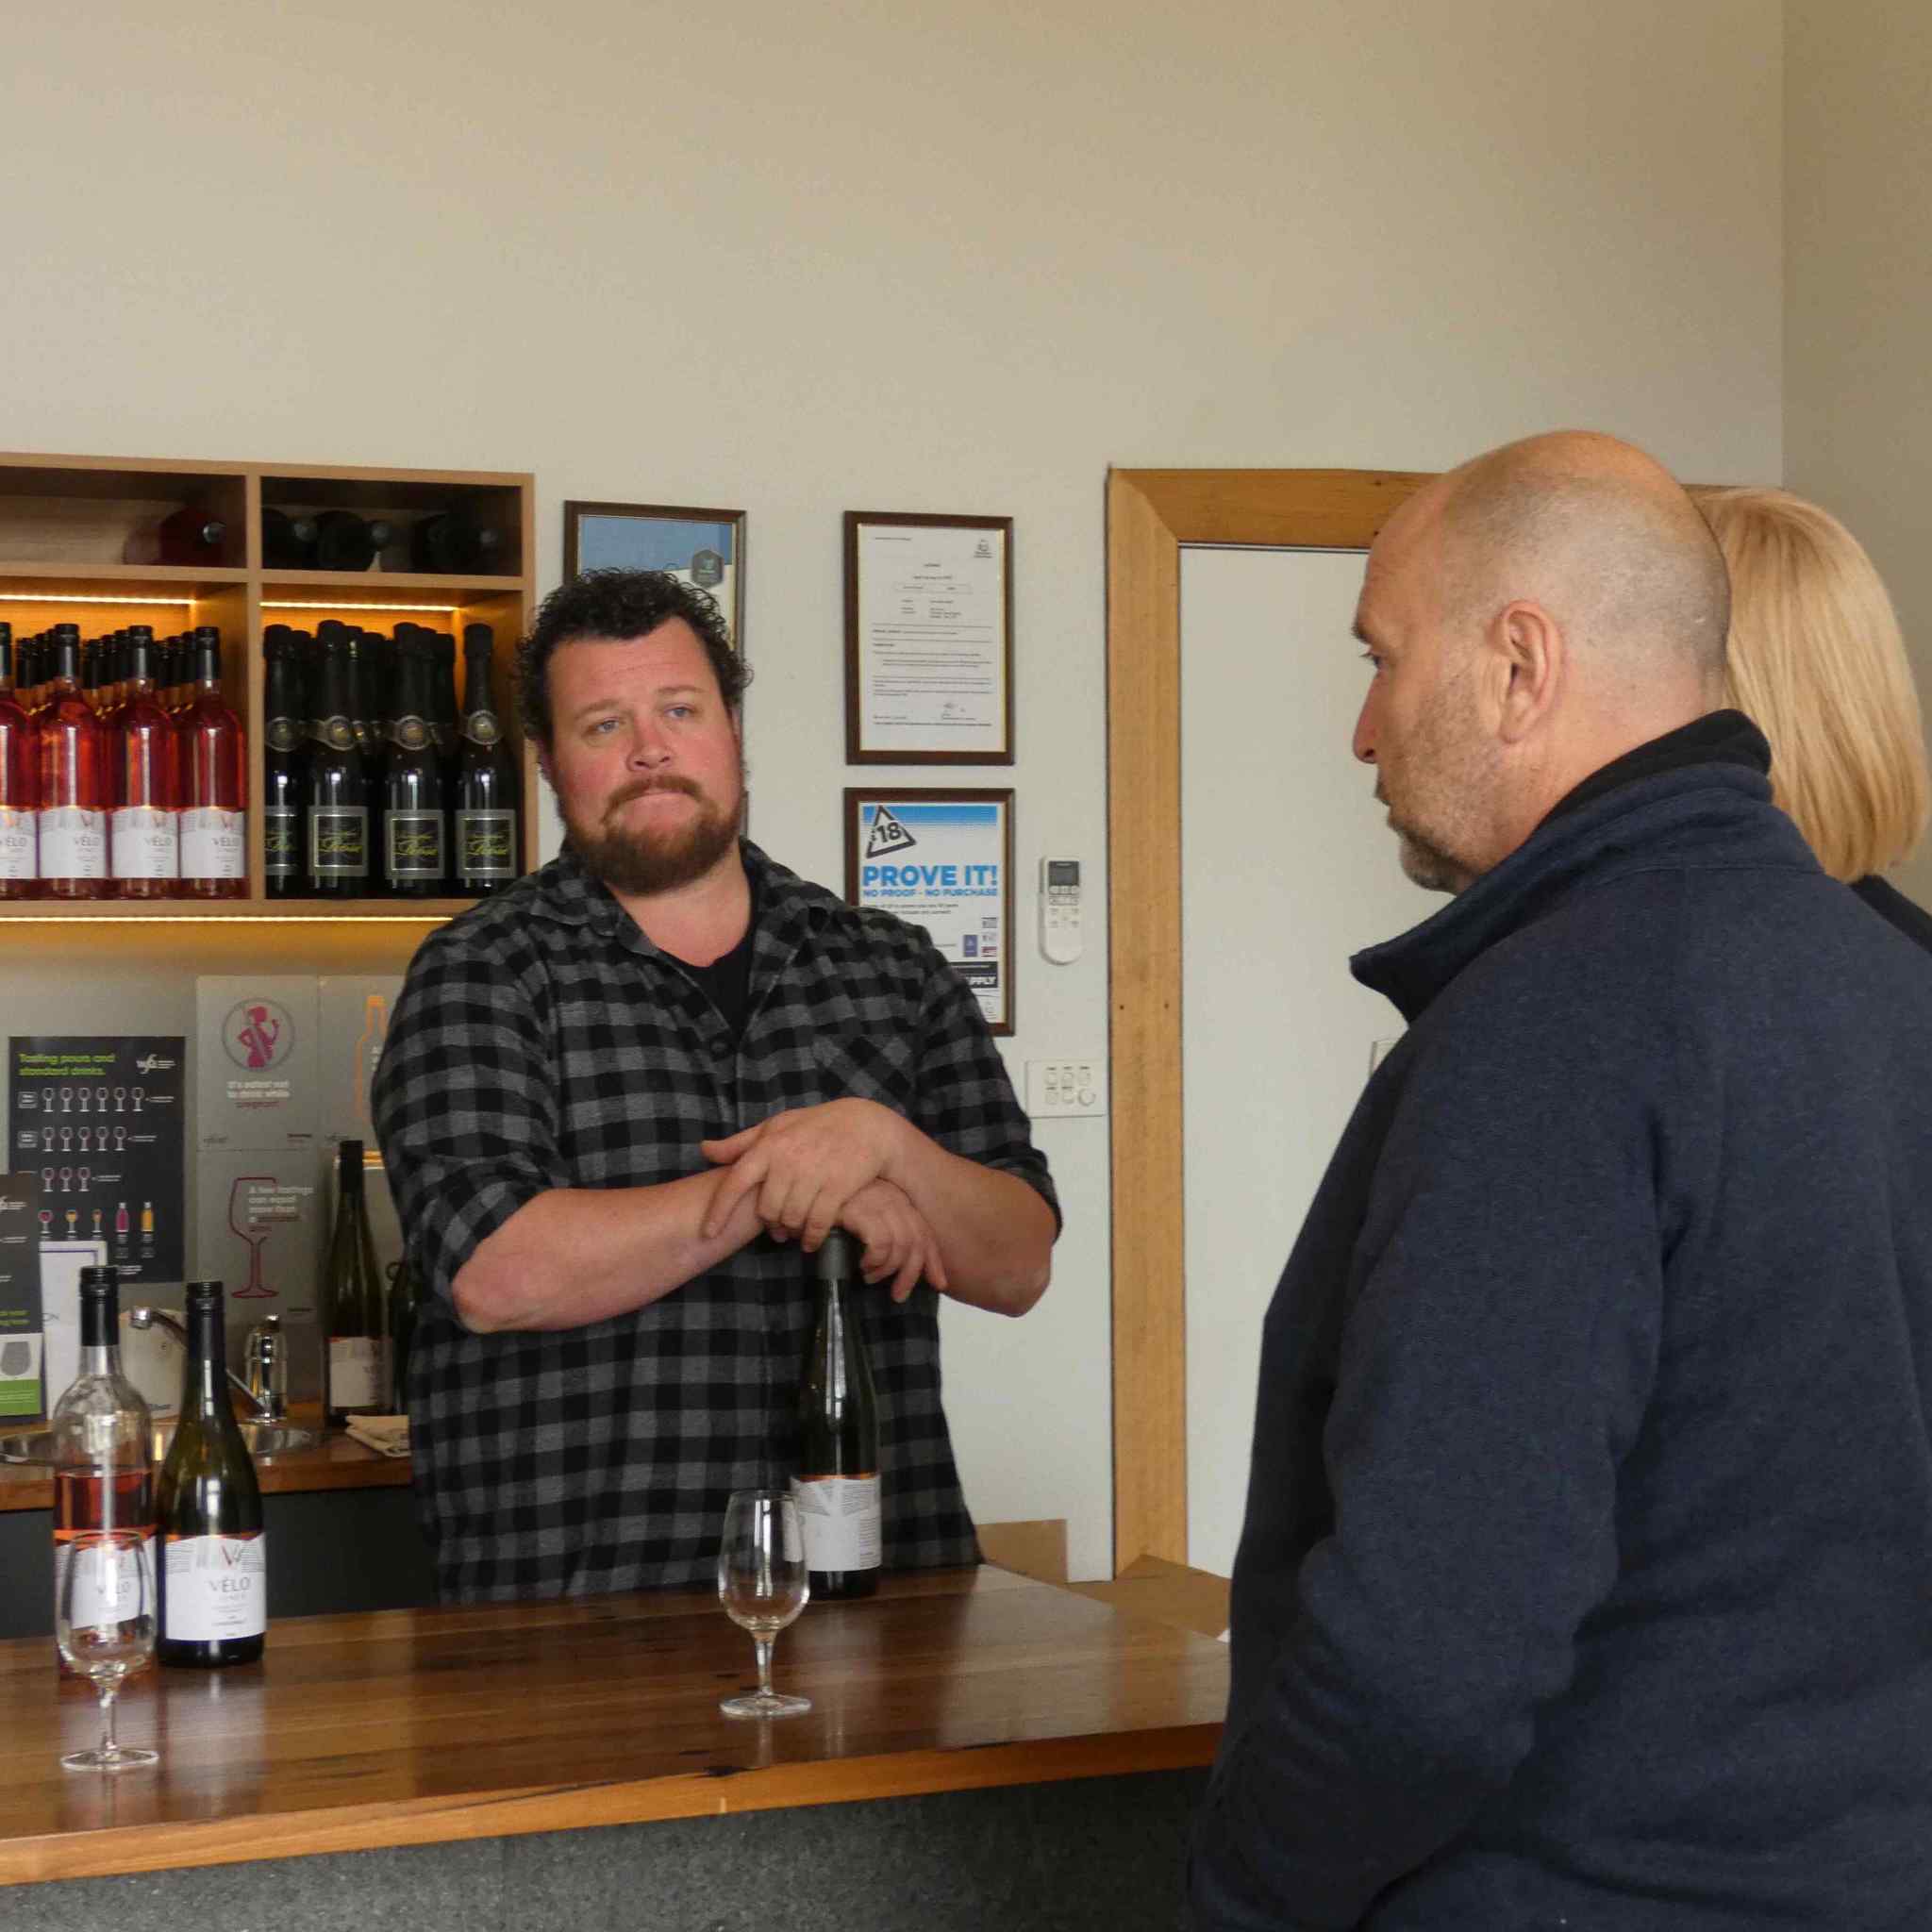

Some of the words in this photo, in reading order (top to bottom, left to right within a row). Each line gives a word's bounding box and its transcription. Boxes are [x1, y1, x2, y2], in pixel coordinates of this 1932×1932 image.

[876, 821, 902, 843] 18
[862, 865, 957, 887] PROVE
[964, 865, 998, 886] IT!
[862, 889, 878, 897] NO
[880, 889, 917, 897] PROOF
[924, 889, 941, 897] NO
[943, 889, 998, 897] PURCHASE
[92, 1053, 116, 1063] and
